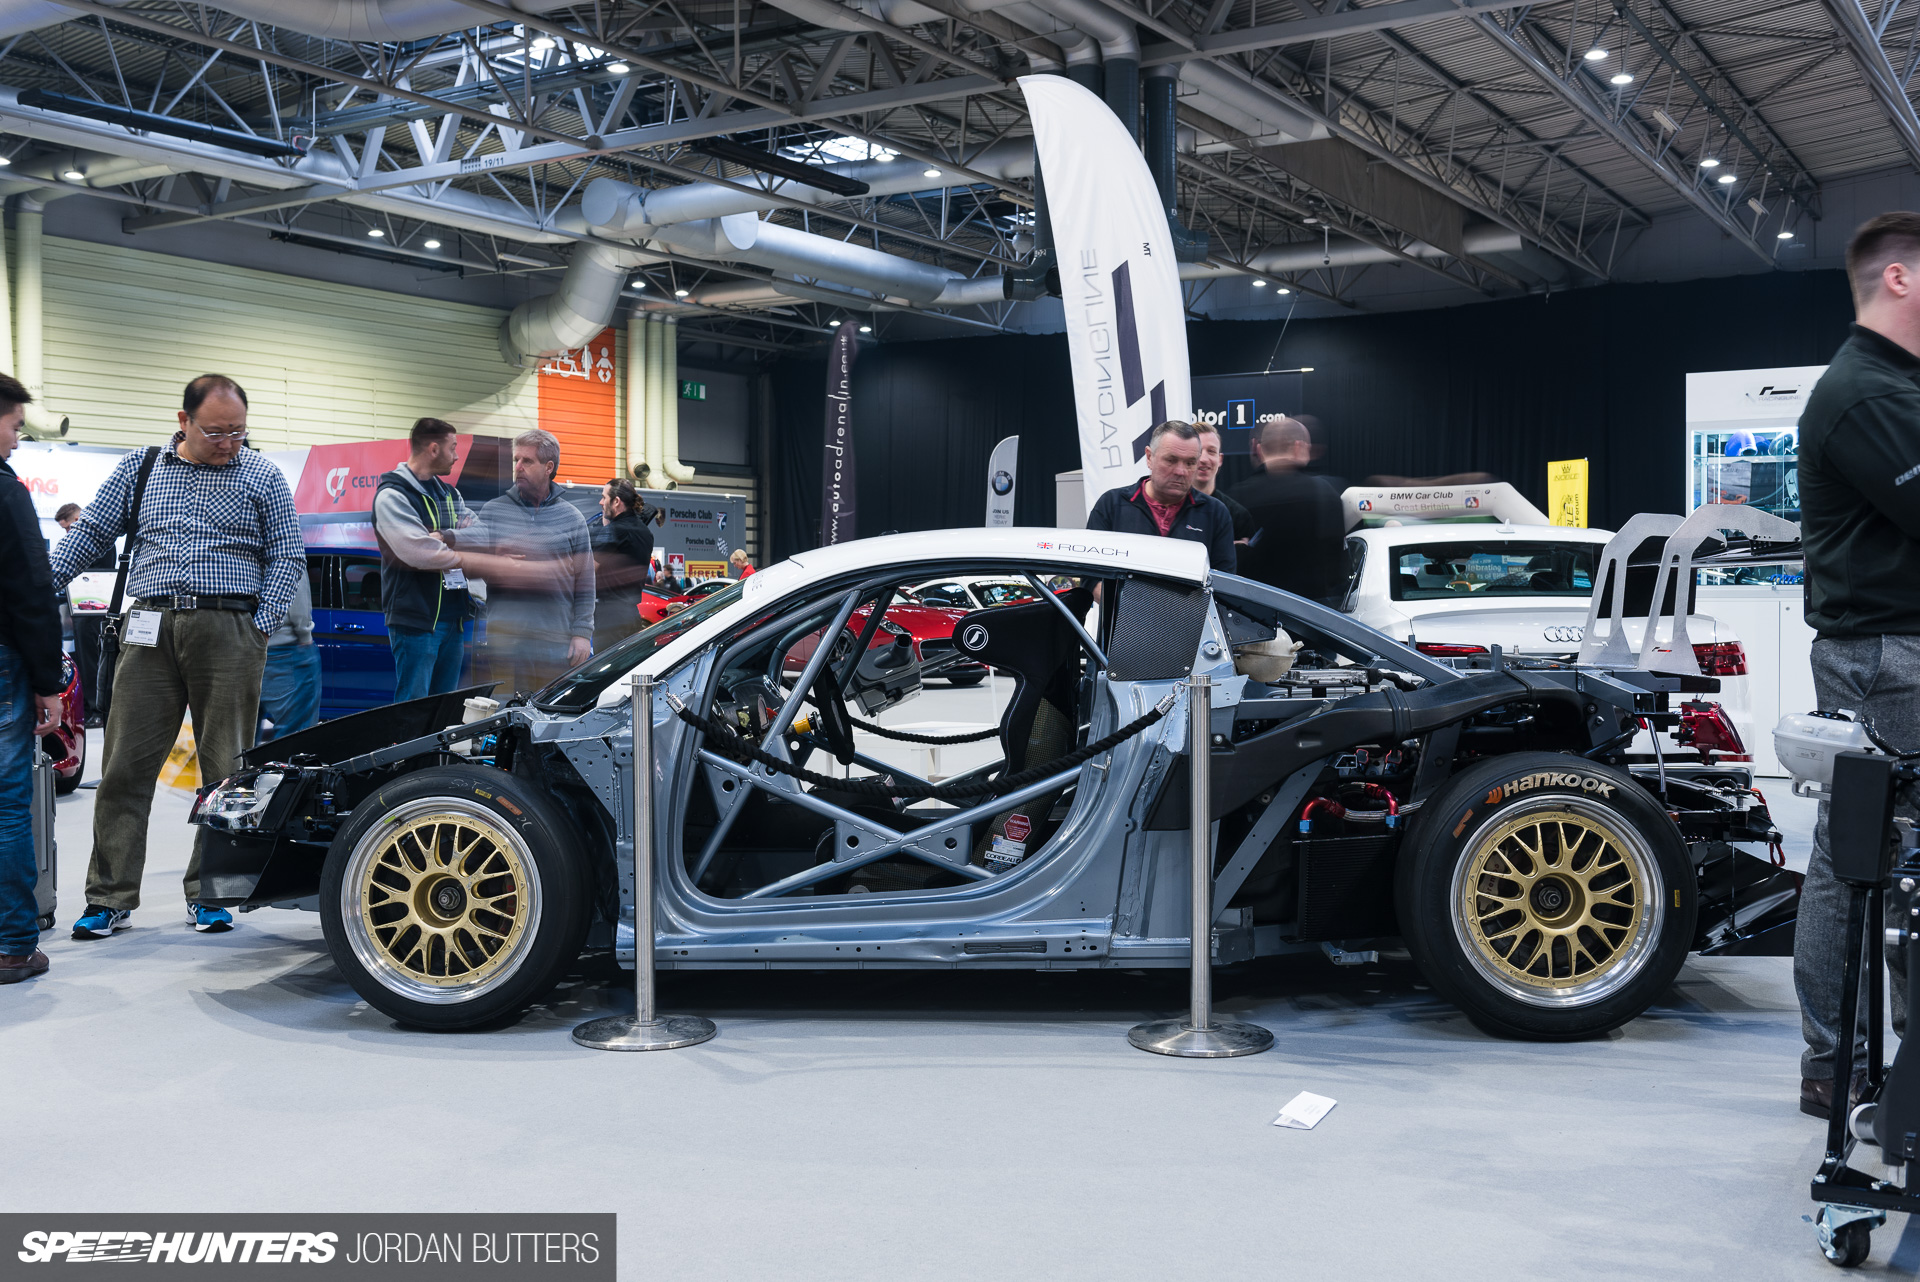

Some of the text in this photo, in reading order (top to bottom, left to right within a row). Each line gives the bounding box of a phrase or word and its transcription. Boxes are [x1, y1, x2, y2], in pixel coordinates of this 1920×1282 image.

[484, 157, 504, 168] 19/11
[825, 334, 852, 547] ww.autoadrenalin.co.uk
[1390, 491, 1454, 500] BMW Car Club
[1393, 502, 1450, 511] Great Britain
[670, 508, 713, 520] Porsche Club
[685, 537, 716, 546] Porsche Club
[1058, 543, 1129, 557] ROACH
